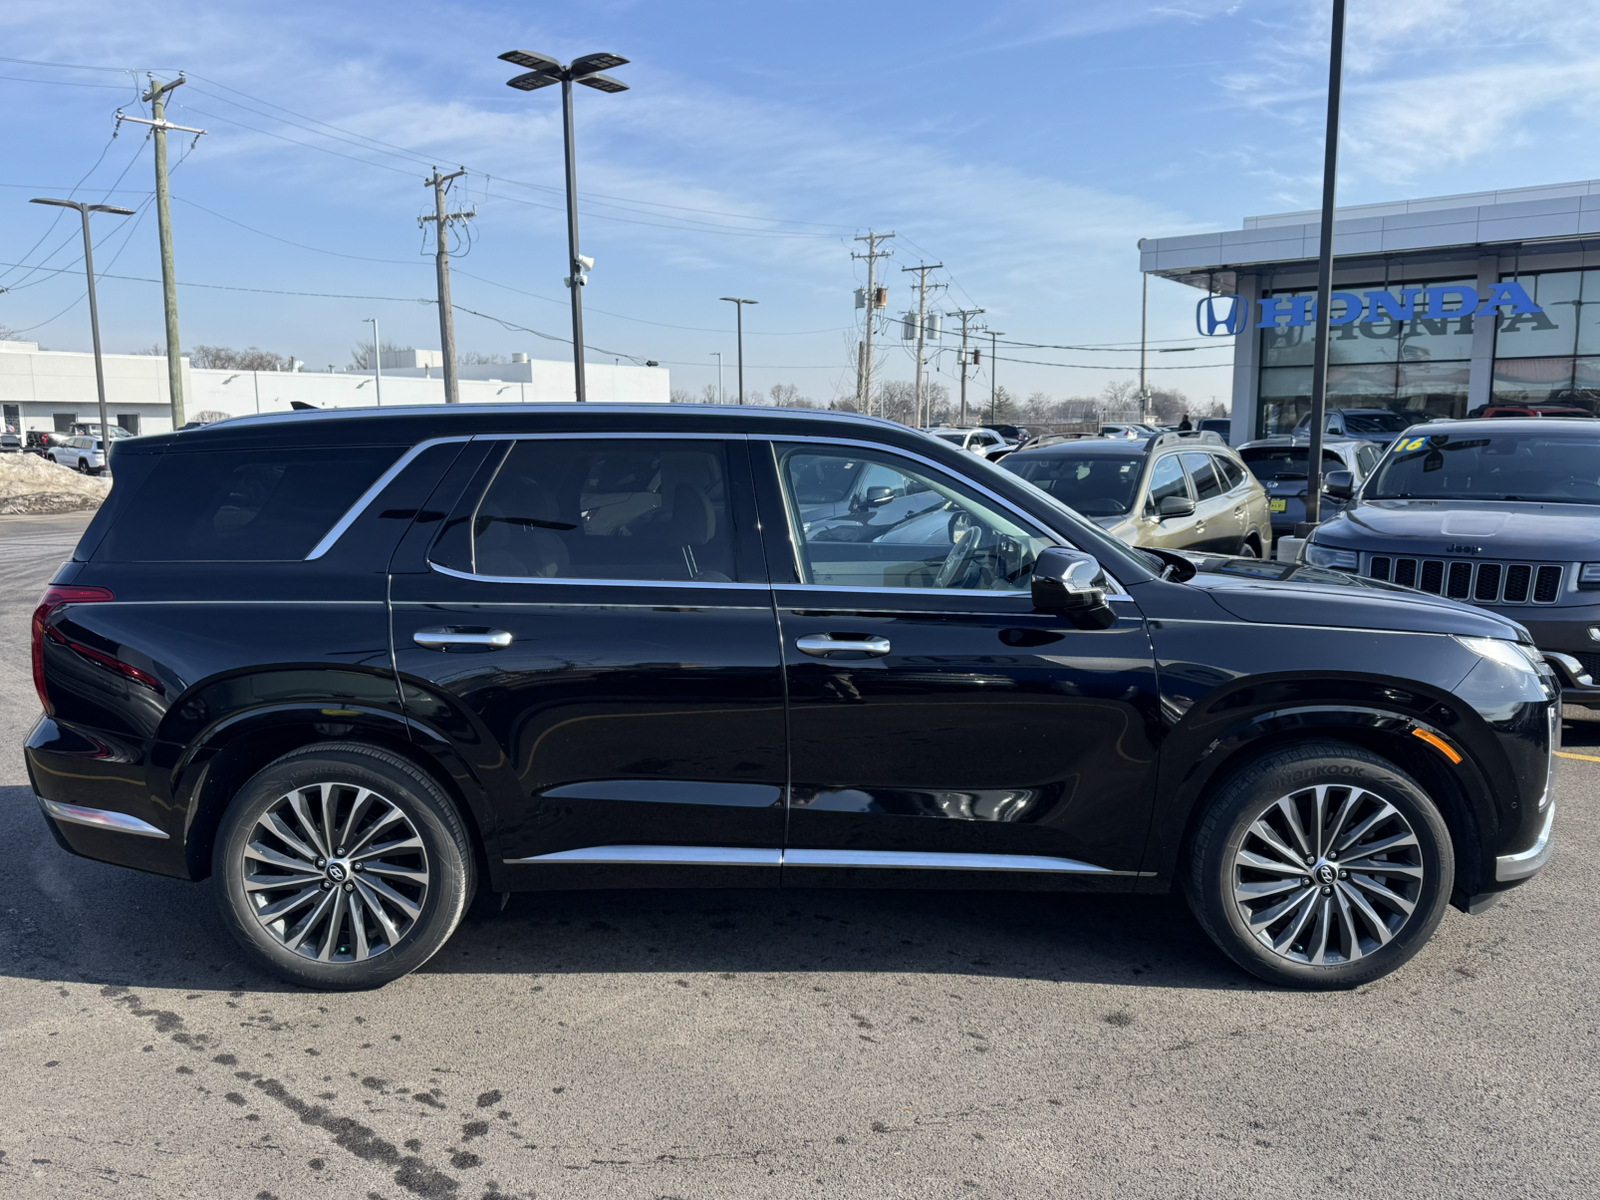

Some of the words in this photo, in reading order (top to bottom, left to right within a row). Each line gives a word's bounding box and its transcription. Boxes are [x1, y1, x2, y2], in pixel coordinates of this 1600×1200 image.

[1255, 282, 1543, 328] HONDA
[1394, 437, 1426, 453] 16
[1446, 543, 1482, 555] Jeep
[1281, 764, 1366, 785] Hankook
